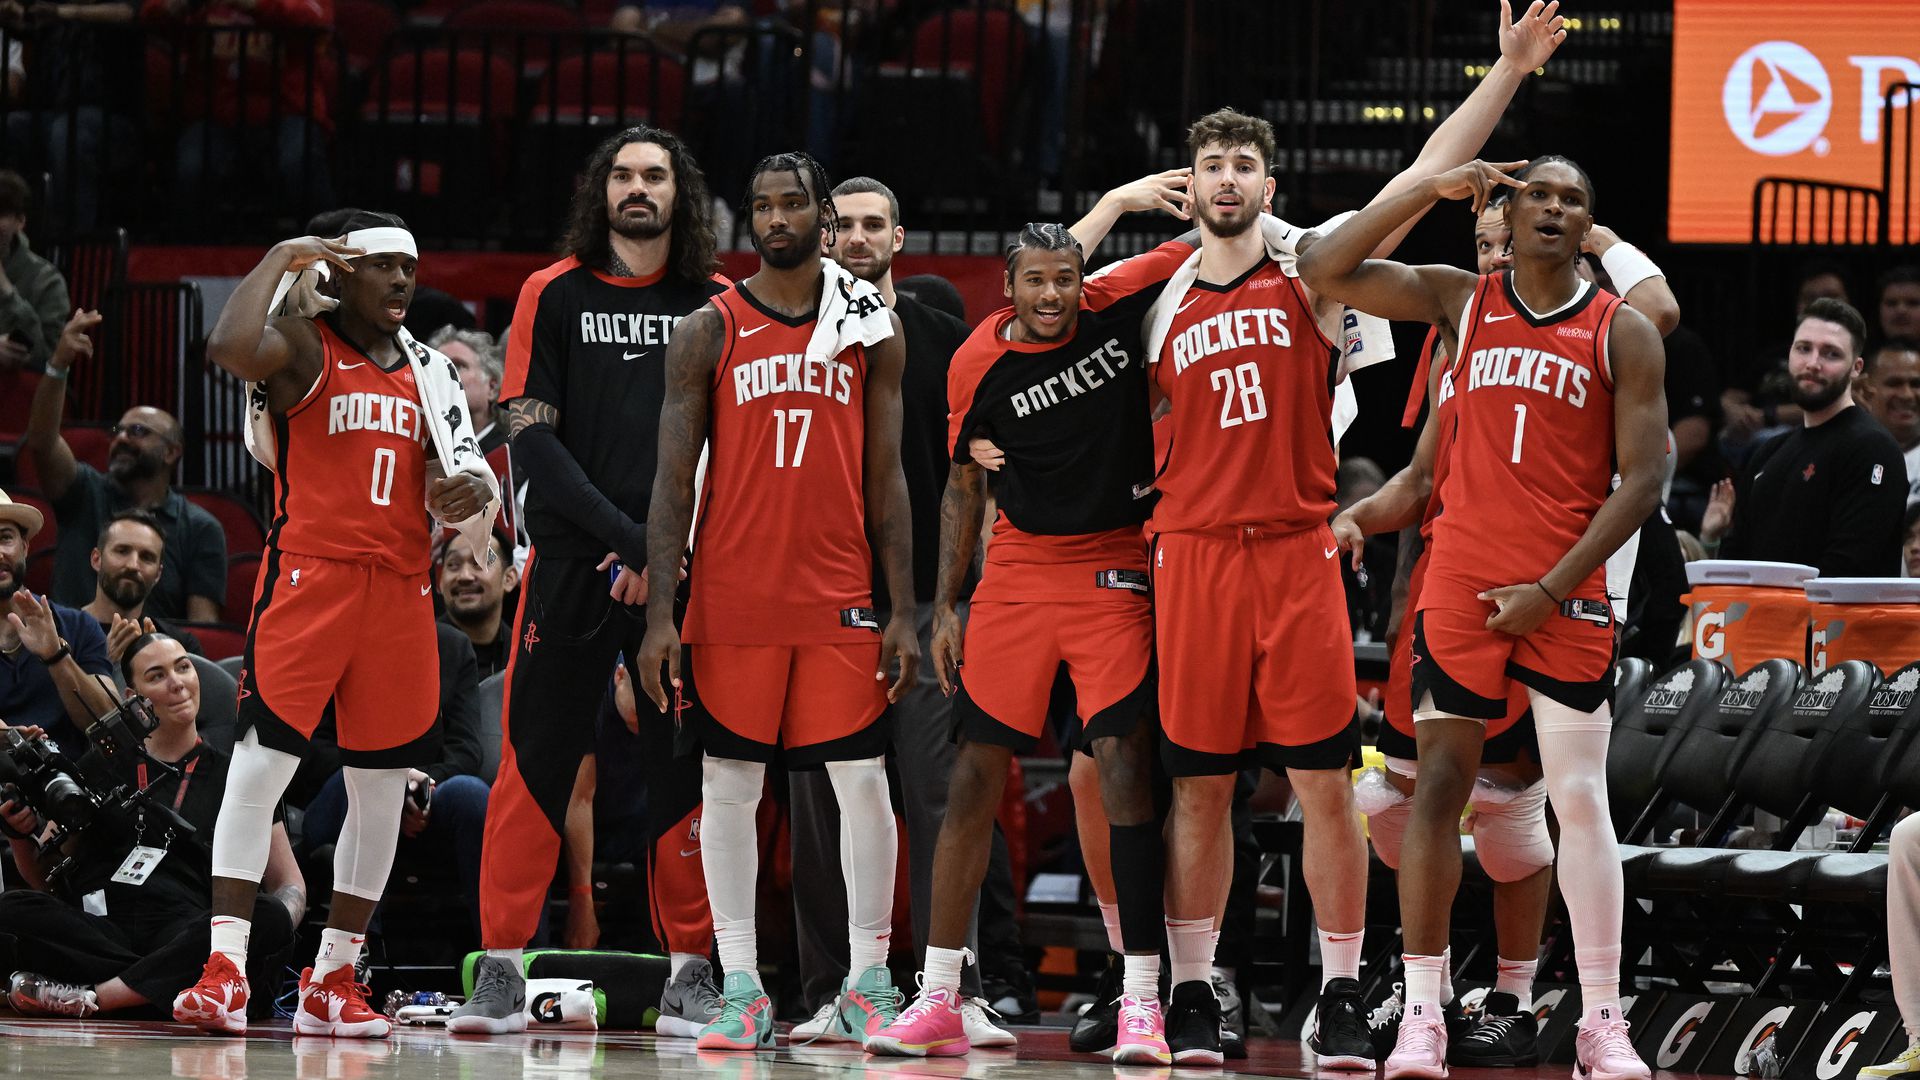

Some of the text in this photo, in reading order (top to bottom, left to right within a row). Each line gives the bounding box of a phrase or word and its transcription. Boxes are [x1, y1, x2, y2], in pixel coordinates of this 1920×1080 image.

[581, 312, 685, 345] ROCKET
[1172, 308, 1291, 377] ROCKETS
[733, 353, 854, 406] ROCKETS
[1010, 338, 1130, 418] ROCKETS
[1210, 361, 1268, 429] 28
[1467, 346, 1591, 409] ROCKETS
[328, 392, 430, 449] ROCKET
[773, 409, 813, 468] 17
[1511, 403, 1527, 464] 1
[370, 447, 396, 506] 0
[1696, 612, 1726, 659] G
[1645, 690, 1674, 705] POST
[1720, 690, 1748, 705] POST
[1795, 692, 1823, 706] POST
[1870, 691, 1898, 706] POST
[531, 992, 563, 1023] G
[1657, 1001, 1716, 1068] G
[1816, 1011, 1878, 1080] G
